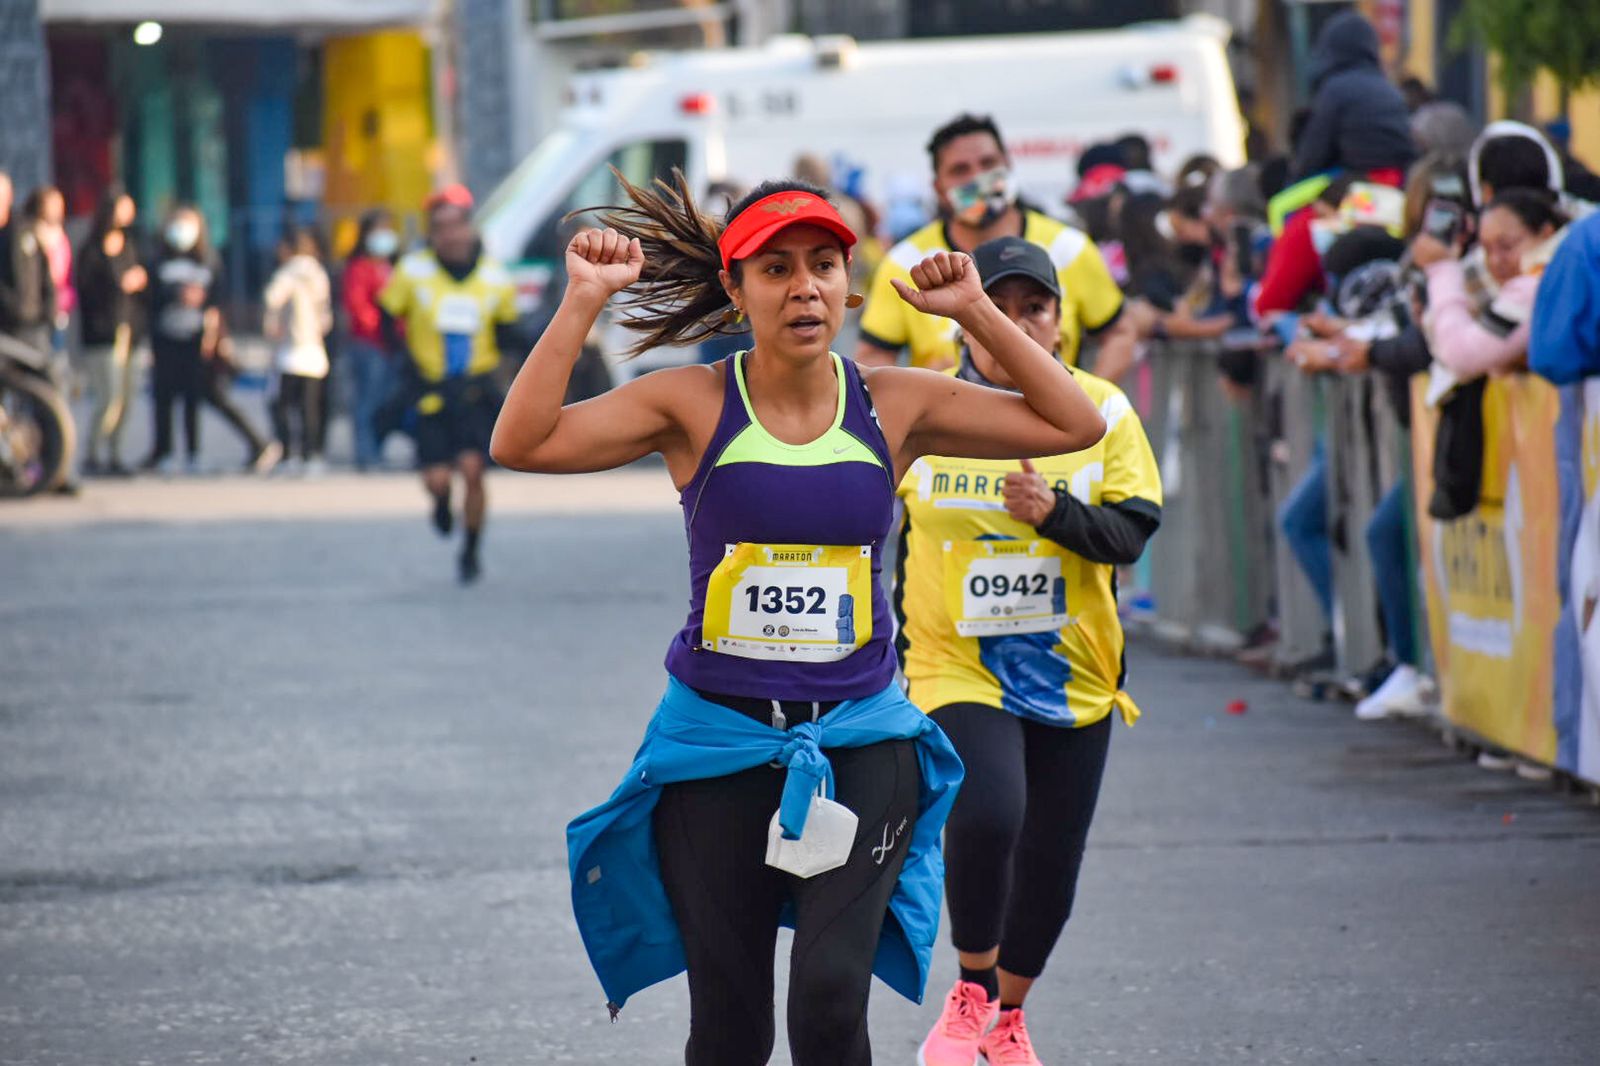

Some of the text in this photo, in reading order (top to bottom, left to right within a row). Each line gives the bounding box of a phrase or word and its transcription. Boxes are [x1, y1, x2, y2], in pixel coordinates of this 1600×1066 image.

[772, 552, 812, 561] MARATON
[970, 573, 1048, 597] 0942
[745, 585, 827, 615] 1352
